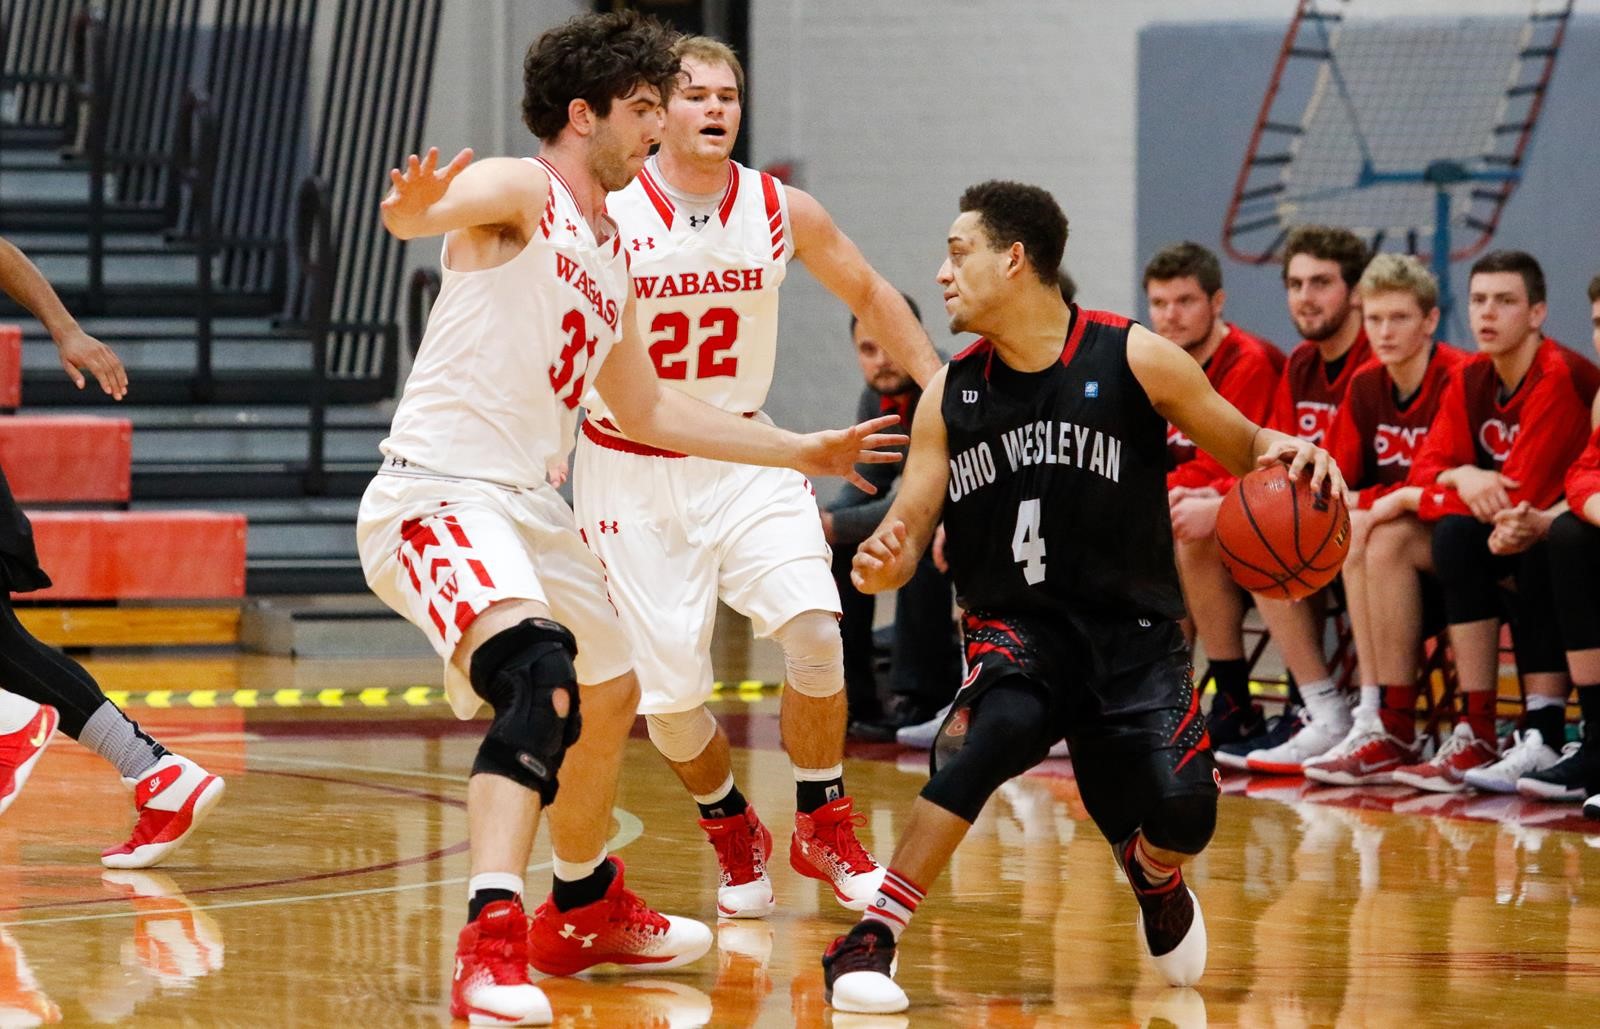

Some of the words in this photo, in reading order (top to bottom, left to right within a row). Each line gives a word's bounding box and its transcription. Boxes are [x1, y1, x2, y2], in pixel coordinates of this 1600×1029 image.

[555, 252, 618, 334] WABAS
[633, 268, 763, 299] WABASH
[648, 307, 739, 380] 22
[949, 441, 997, 503] OHIO
[1001, 420, 1122, 484] WESLEYAN
[1011, 498, 1047, 586] 4
